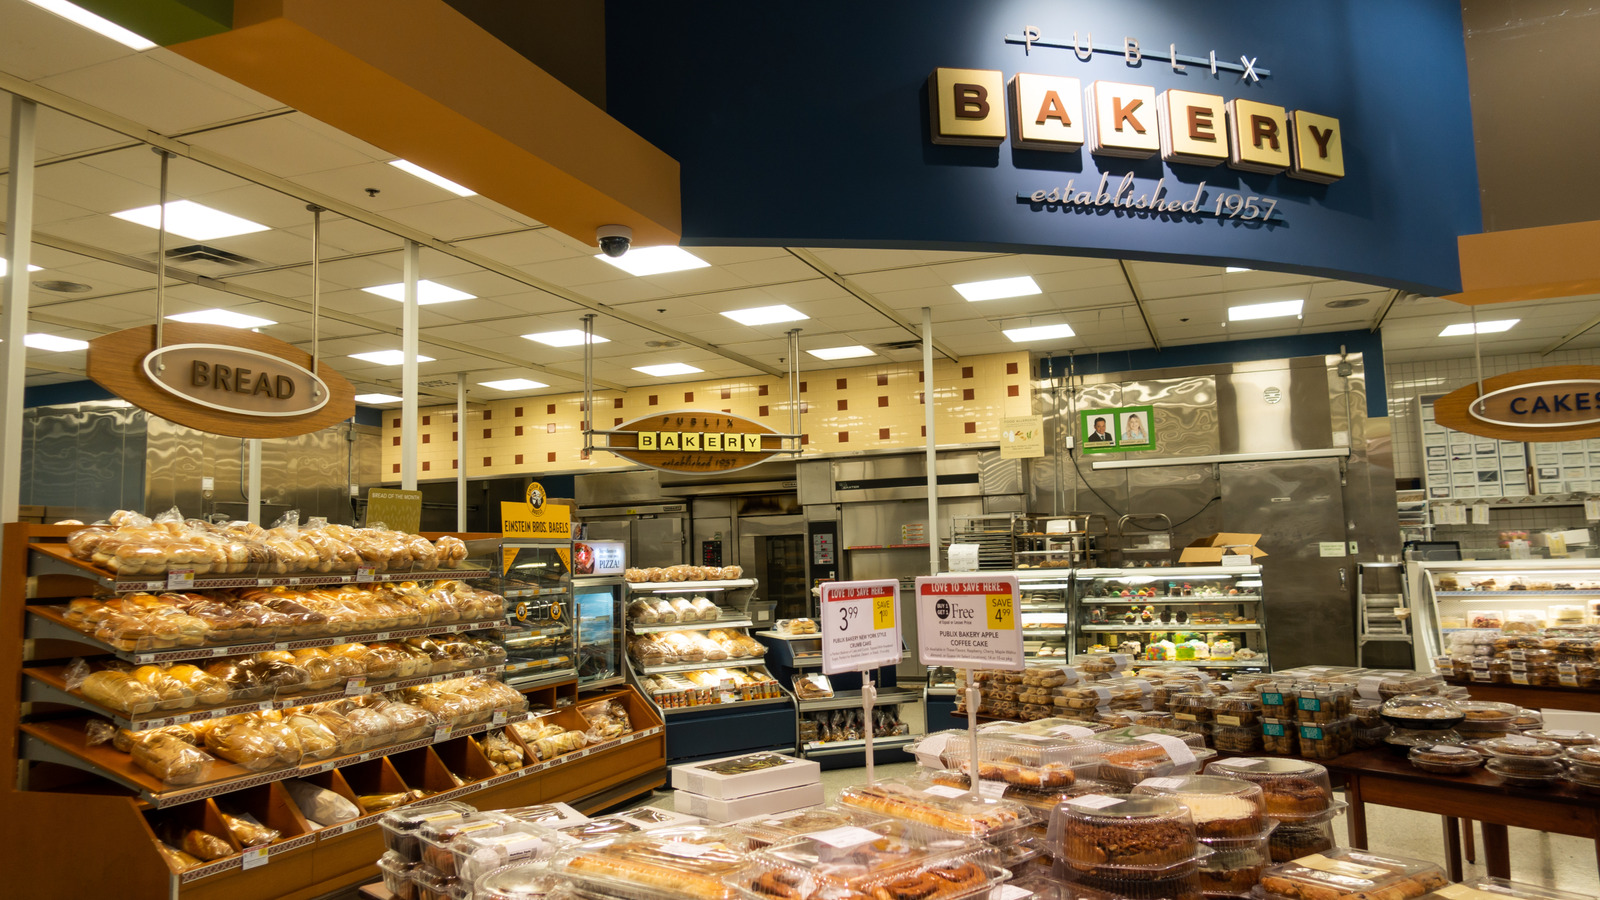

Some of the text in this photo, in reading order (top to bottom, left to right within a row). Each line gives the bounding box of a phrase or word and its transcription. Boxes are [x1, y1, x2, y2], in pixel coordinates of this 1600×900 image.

[1024, 25, 1260, 83] PUBLIX
[953, 82, 1334, 159] BAKERY
[1030, 170, 1278, 223] established 1957
[192, 359, 296, 400] BREAD
[663, 416, 734, 427] PUBLIX
[642, 435, 757, 448] BAKERY
[662, 455, 737, 467] established 1957
[504, 520, 569, 534] EINSTEIN BROS. BAGELS
[599, 559, 620, 569] PIZZA!
[831, 586, 885, 599] LOVE TO SAVE HERE.
[931, 582, 1004, 592] LOVE TO SAVE HERE.
[876, 600, 890, 610] SAVE
[991, 598, 1012, 608] SAVE
[951, 603, 975, 619] Free
[939, 630, 999, 639] PUBLIX BAKERY APPLE
[950, 639, 989, 648] COFFEE CAKE
